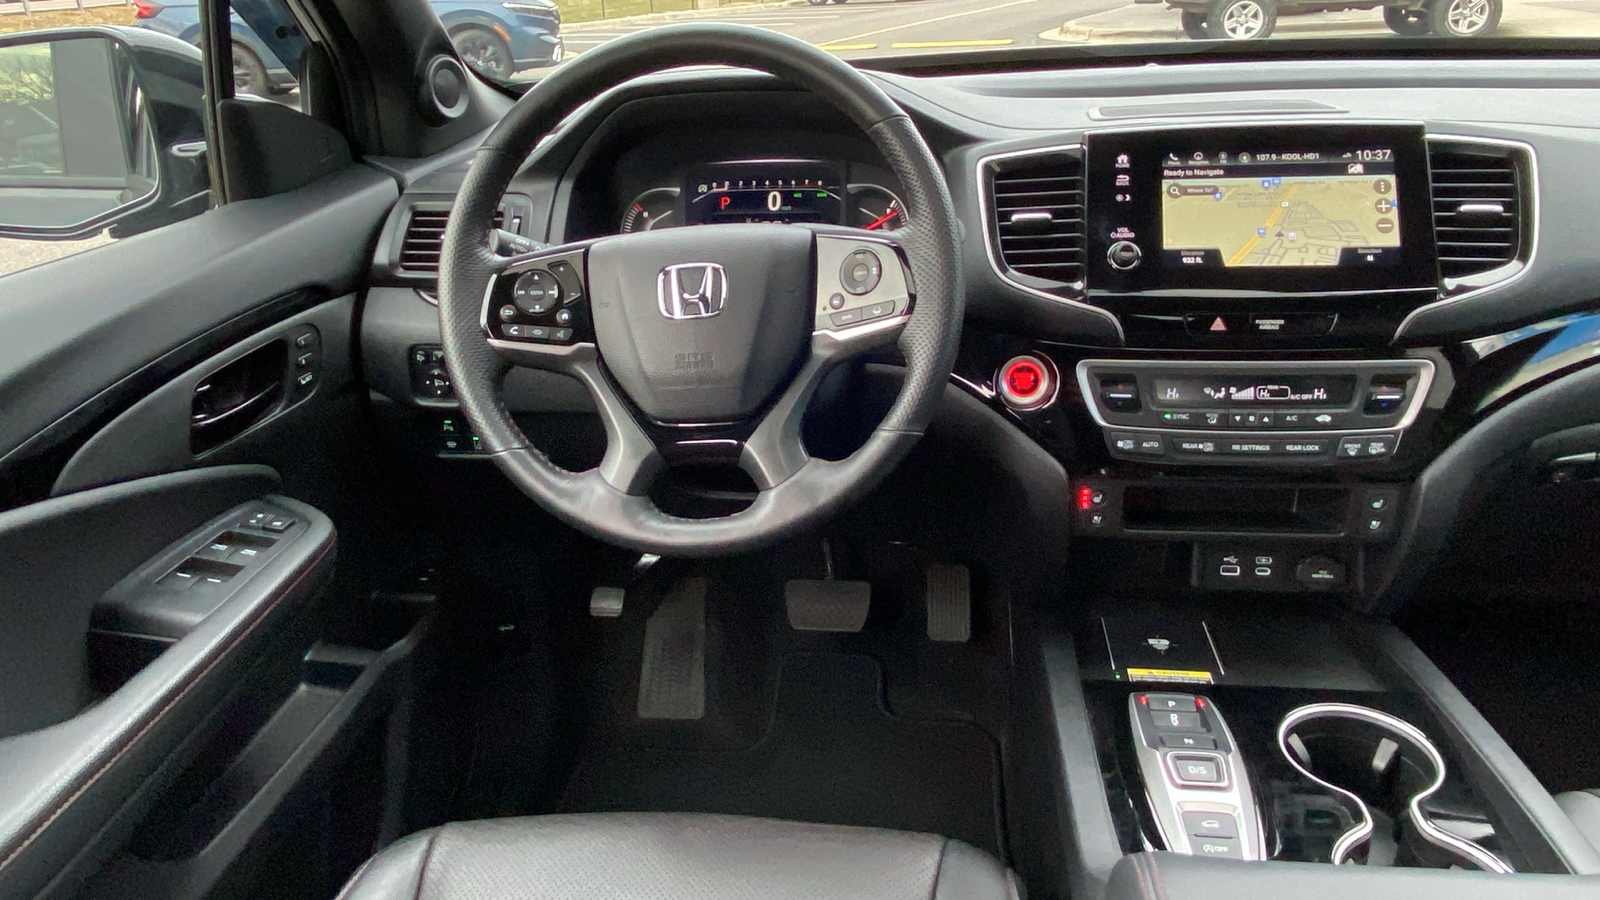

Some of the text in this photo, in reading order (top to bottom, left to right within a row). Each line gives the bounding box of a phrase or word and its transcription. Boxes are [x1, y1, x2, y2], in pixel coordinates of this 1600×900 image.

[1355, 149, 1391, 160] 10:37
[1163, 169, 1185, 177] Ready
[1194, 168, 1224, 177] Navigate
[720, 197, 731, 209] P
[767, 190, 782, 211] 0
[1168, 700, 1176, 708] P
[1188, 765, 1207, 775] D/S
